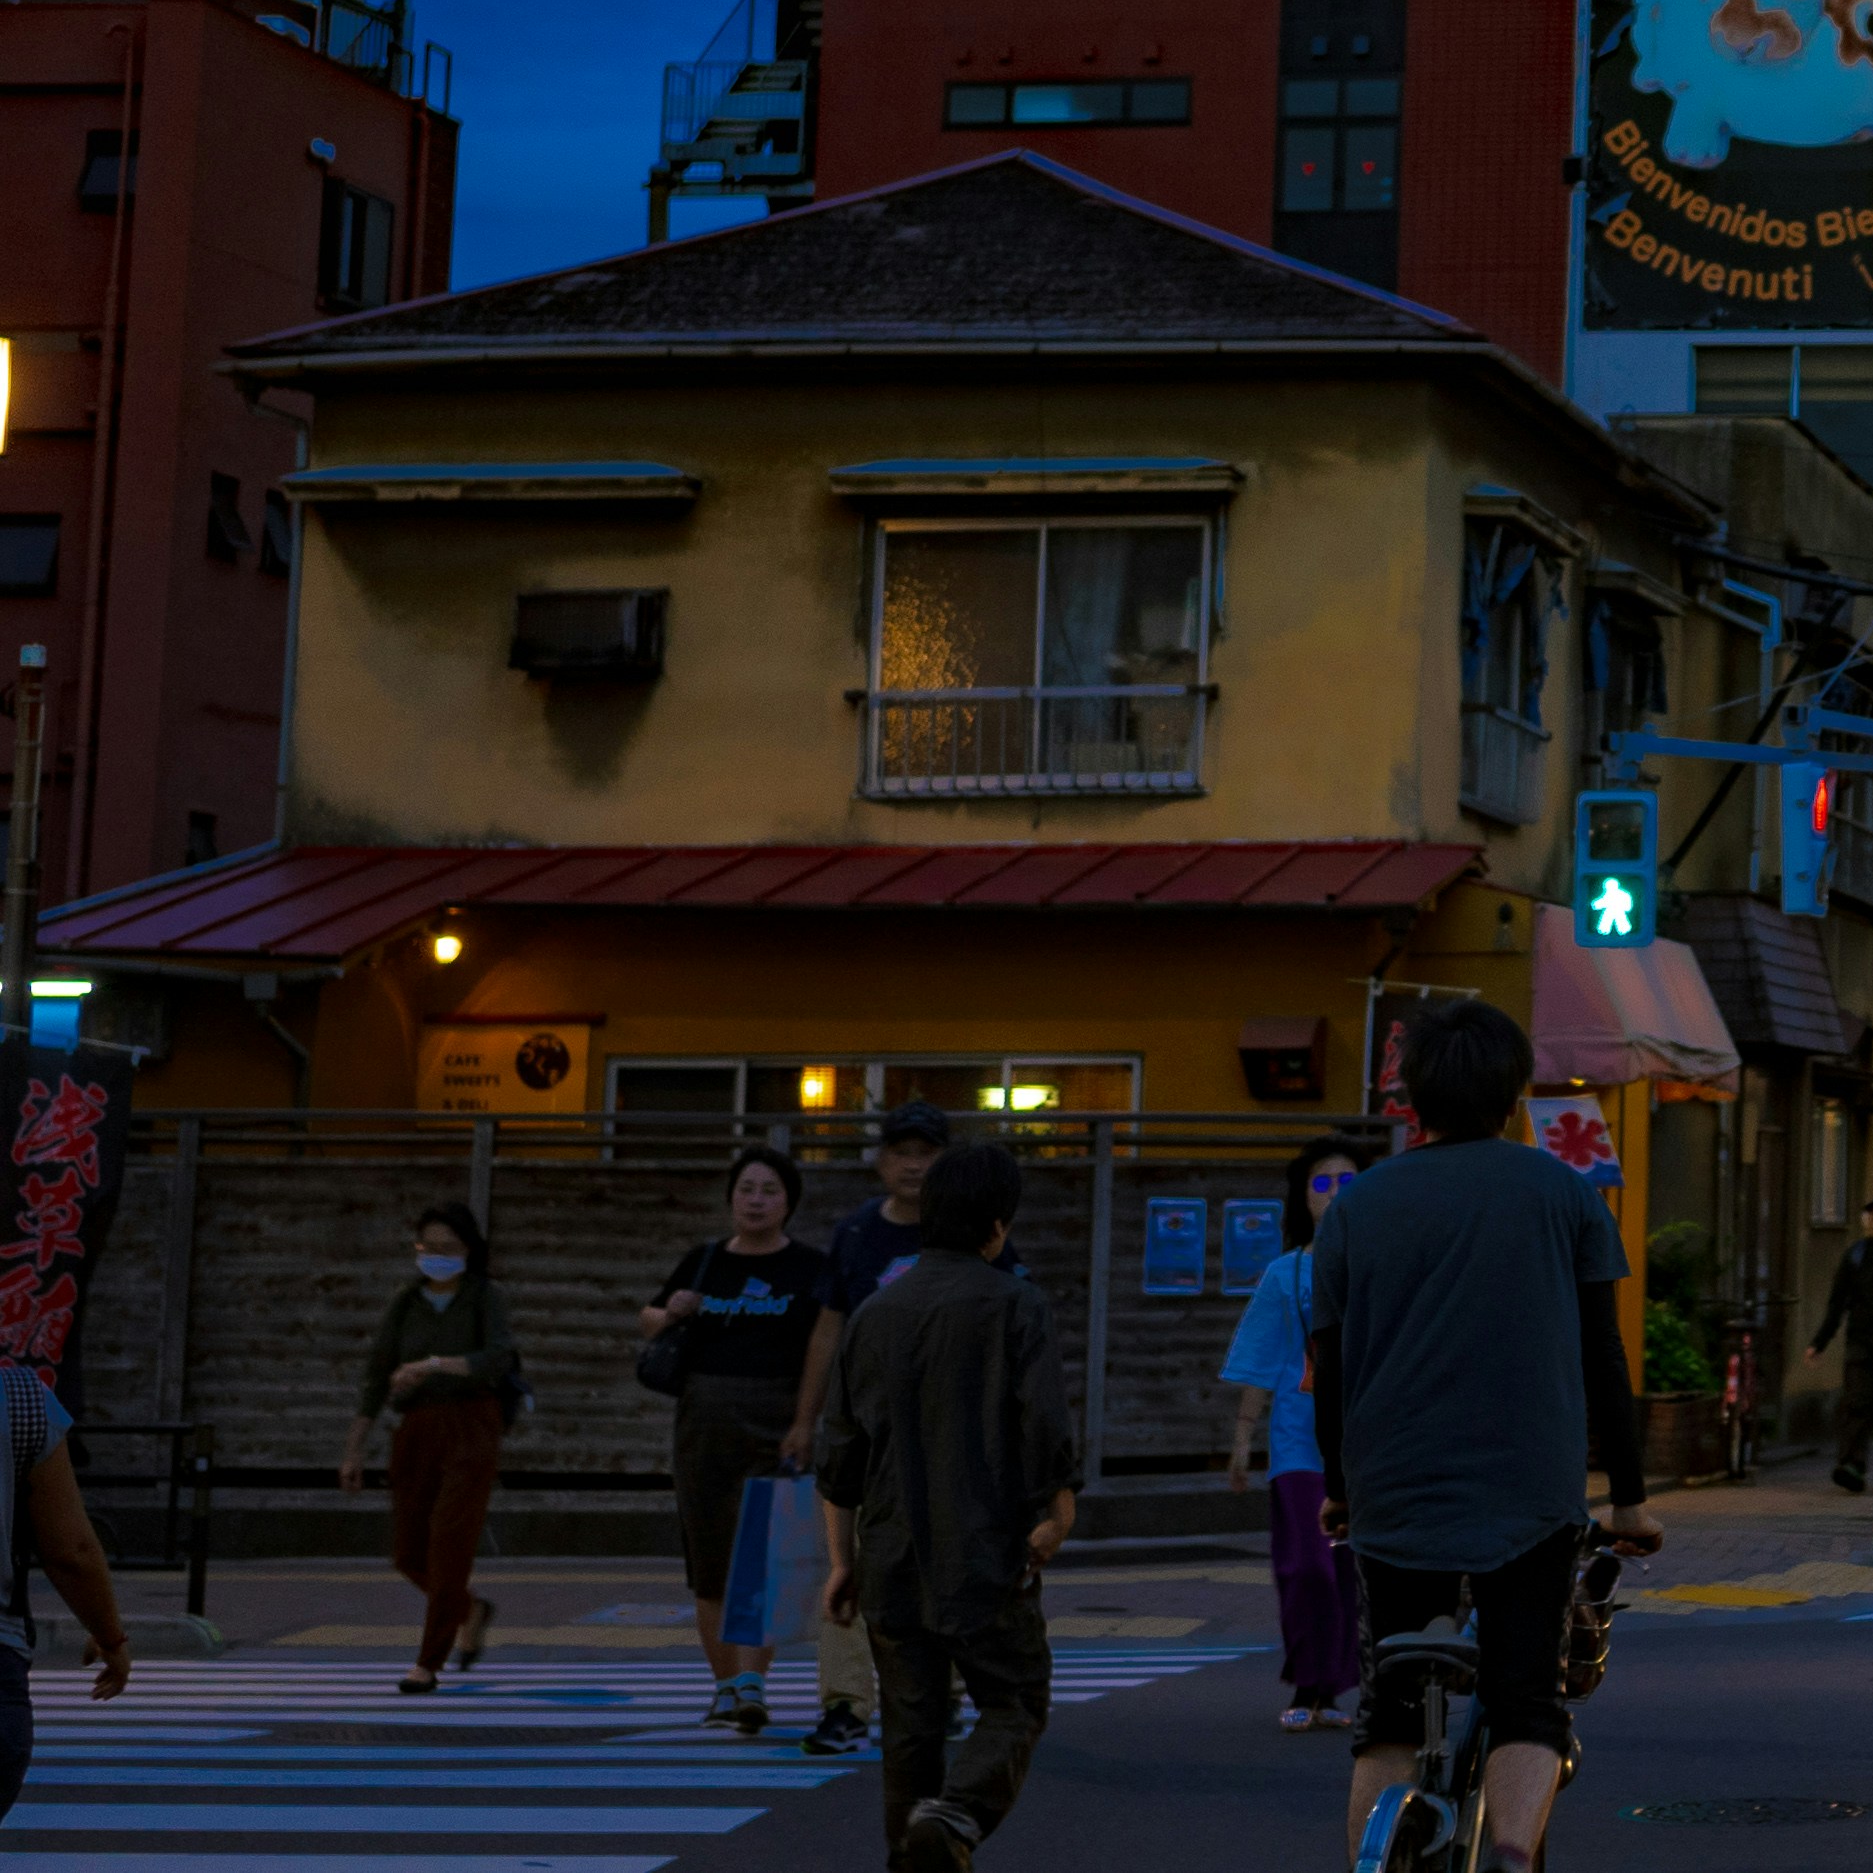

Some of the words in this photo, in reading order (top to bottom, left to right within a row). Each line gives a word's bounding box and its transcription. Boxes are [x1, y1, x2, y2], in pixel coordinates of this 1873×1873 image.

[1602, 118, 1808, 249] Bienvenidos
[1603, 209, 1814, 302] Benvenuti
[1544, 1111, 1611, 1165] 氷
